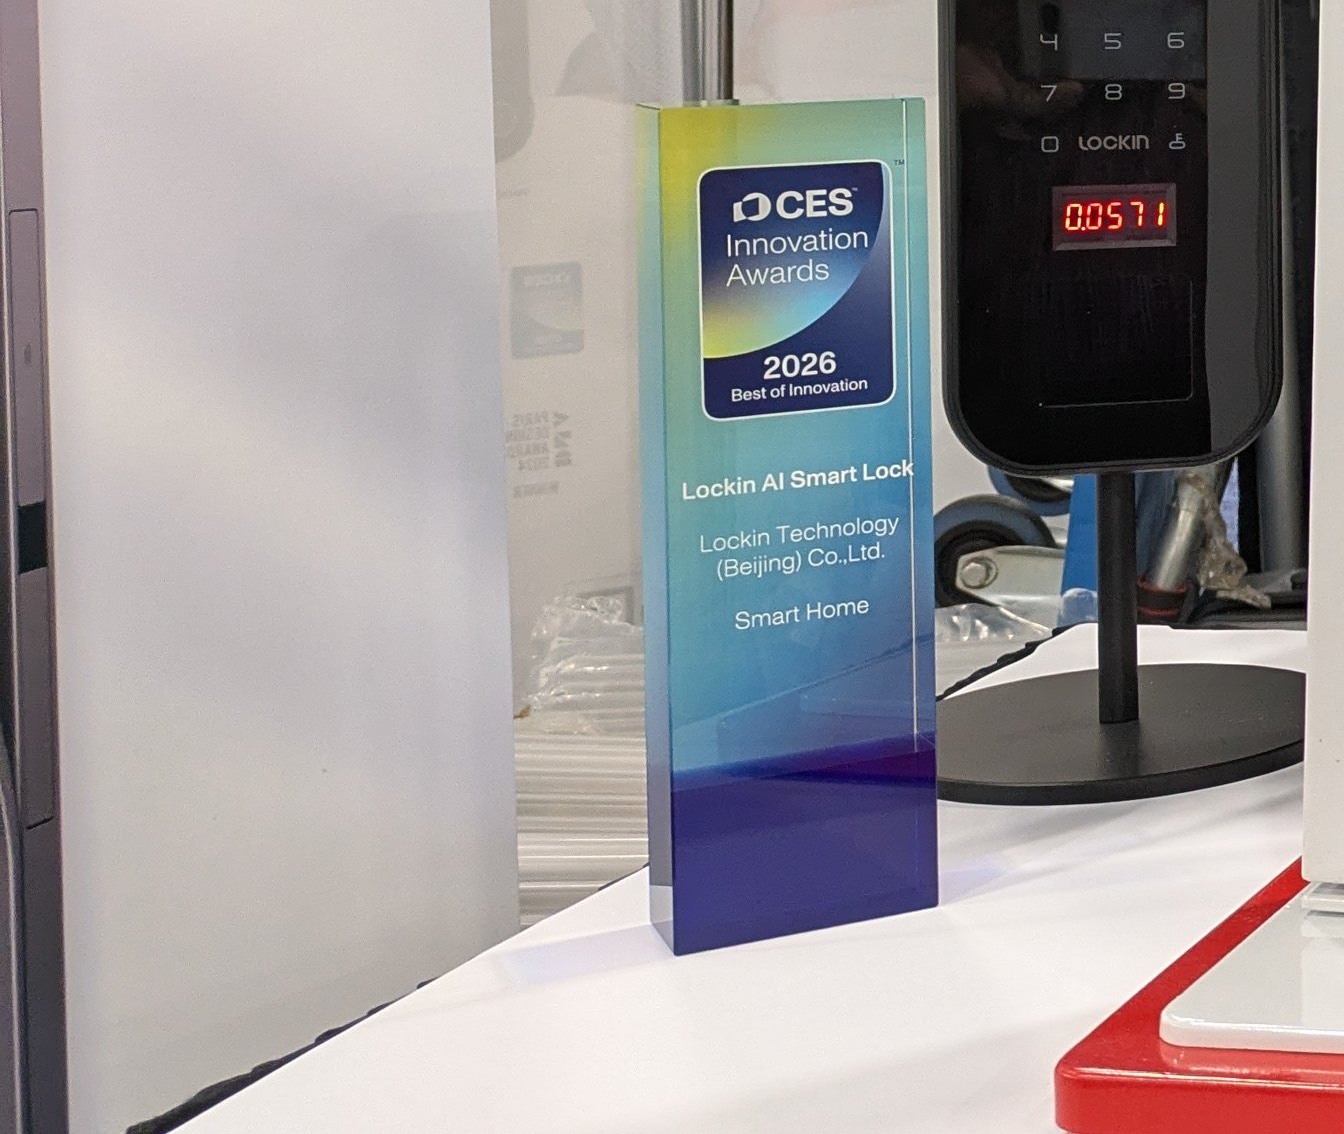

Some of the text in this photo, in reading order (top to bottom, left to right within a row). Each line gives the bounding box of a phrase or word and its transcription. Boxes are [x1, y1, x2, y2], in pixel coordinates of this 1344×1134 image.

[1039, 32, 1185, 51] 4 5 6
[1040, 82, 1186, 102] 7 8 9
[1078, 134, 1149, 151] LOCKIN
[776, 188, 854, 219] CES
[1065, 201, 1165, 231] 0.0571
[726, 227, 869, 257] Innovation
[725, 259, 830, 287] Awards
[763, 350, 837, 380] 2026
[731, 378, 869, 402] Best of Innovation
[682, 459, 914, 500] Lockin AI Smart Lock
[699, 517, 900, 553] Lockin Technology
[716, 542, 886, 581] (Beijing) Co.,Ltd.
[735, 599, 870, 630] Smart Home
